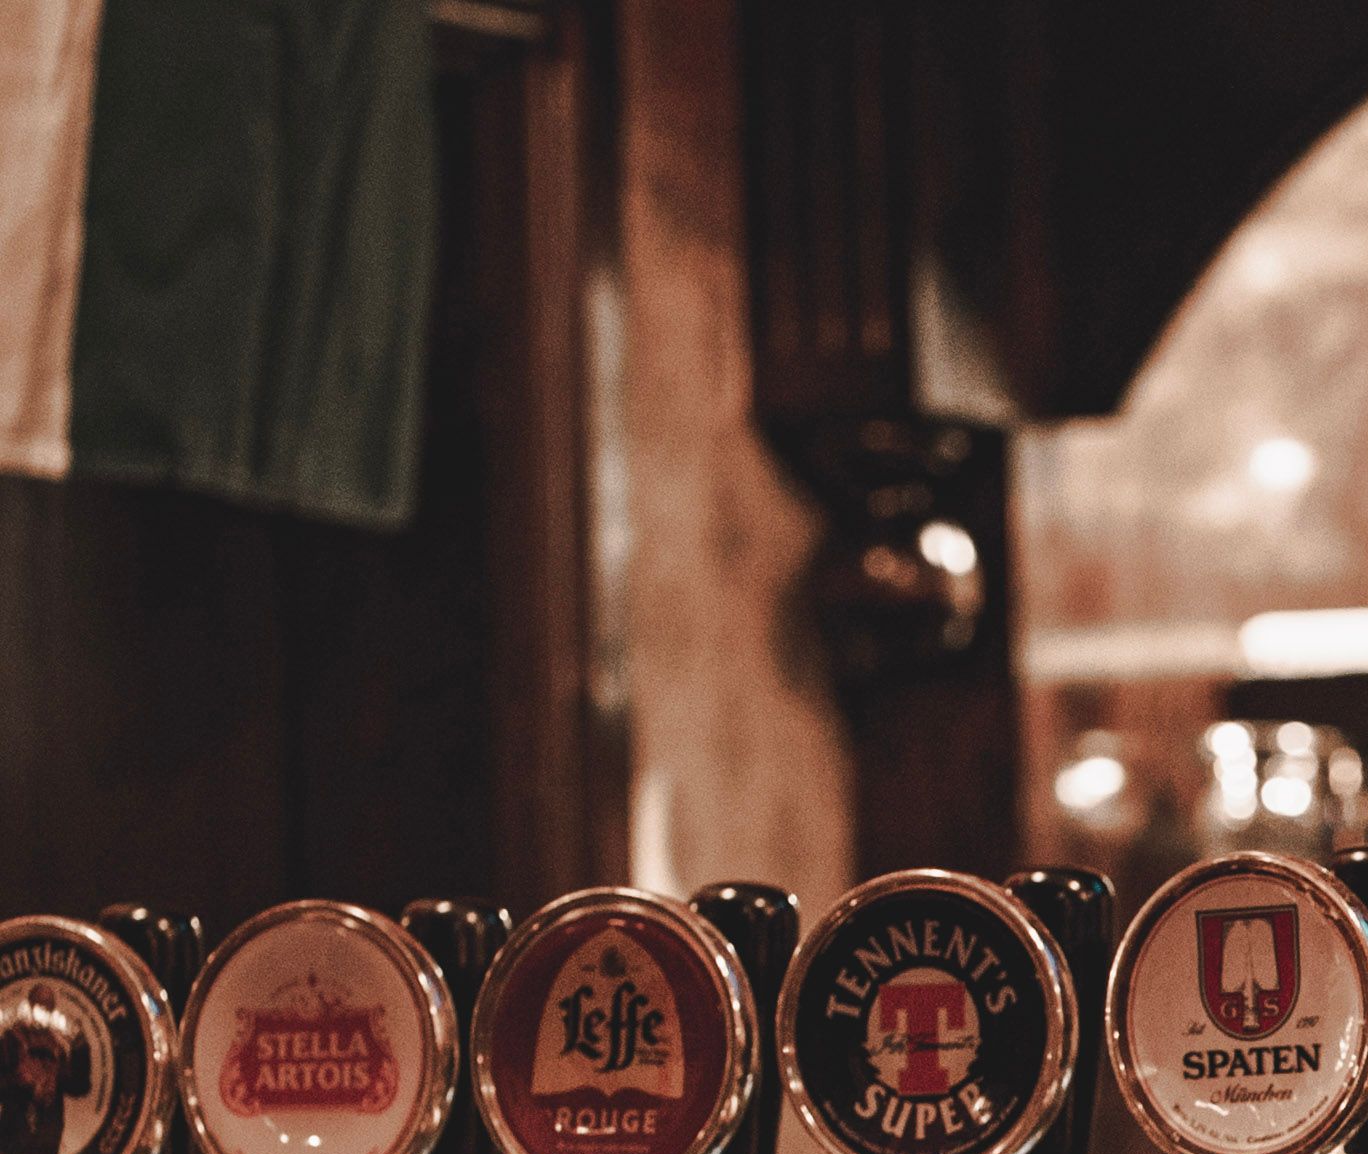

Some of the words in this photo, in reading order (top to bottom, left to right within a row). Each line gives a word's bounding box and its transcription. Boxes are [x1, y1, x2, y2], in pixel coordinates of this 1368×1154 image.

[825, 919, 1017, 1020] TENNENT'S
[558, 980, 666, 1073] Leffe
[256, 1031, 369, 1060] STELLA
[1182, 1042, 1323, 1081] SPATEN
[255, 1062, 371, 1090] ARTOIS
[854, 1081, 992, 1140] SUPER
[1209, 1083, 1294, 1105] München
[555, 1106, 659, 1136] ROUGE
